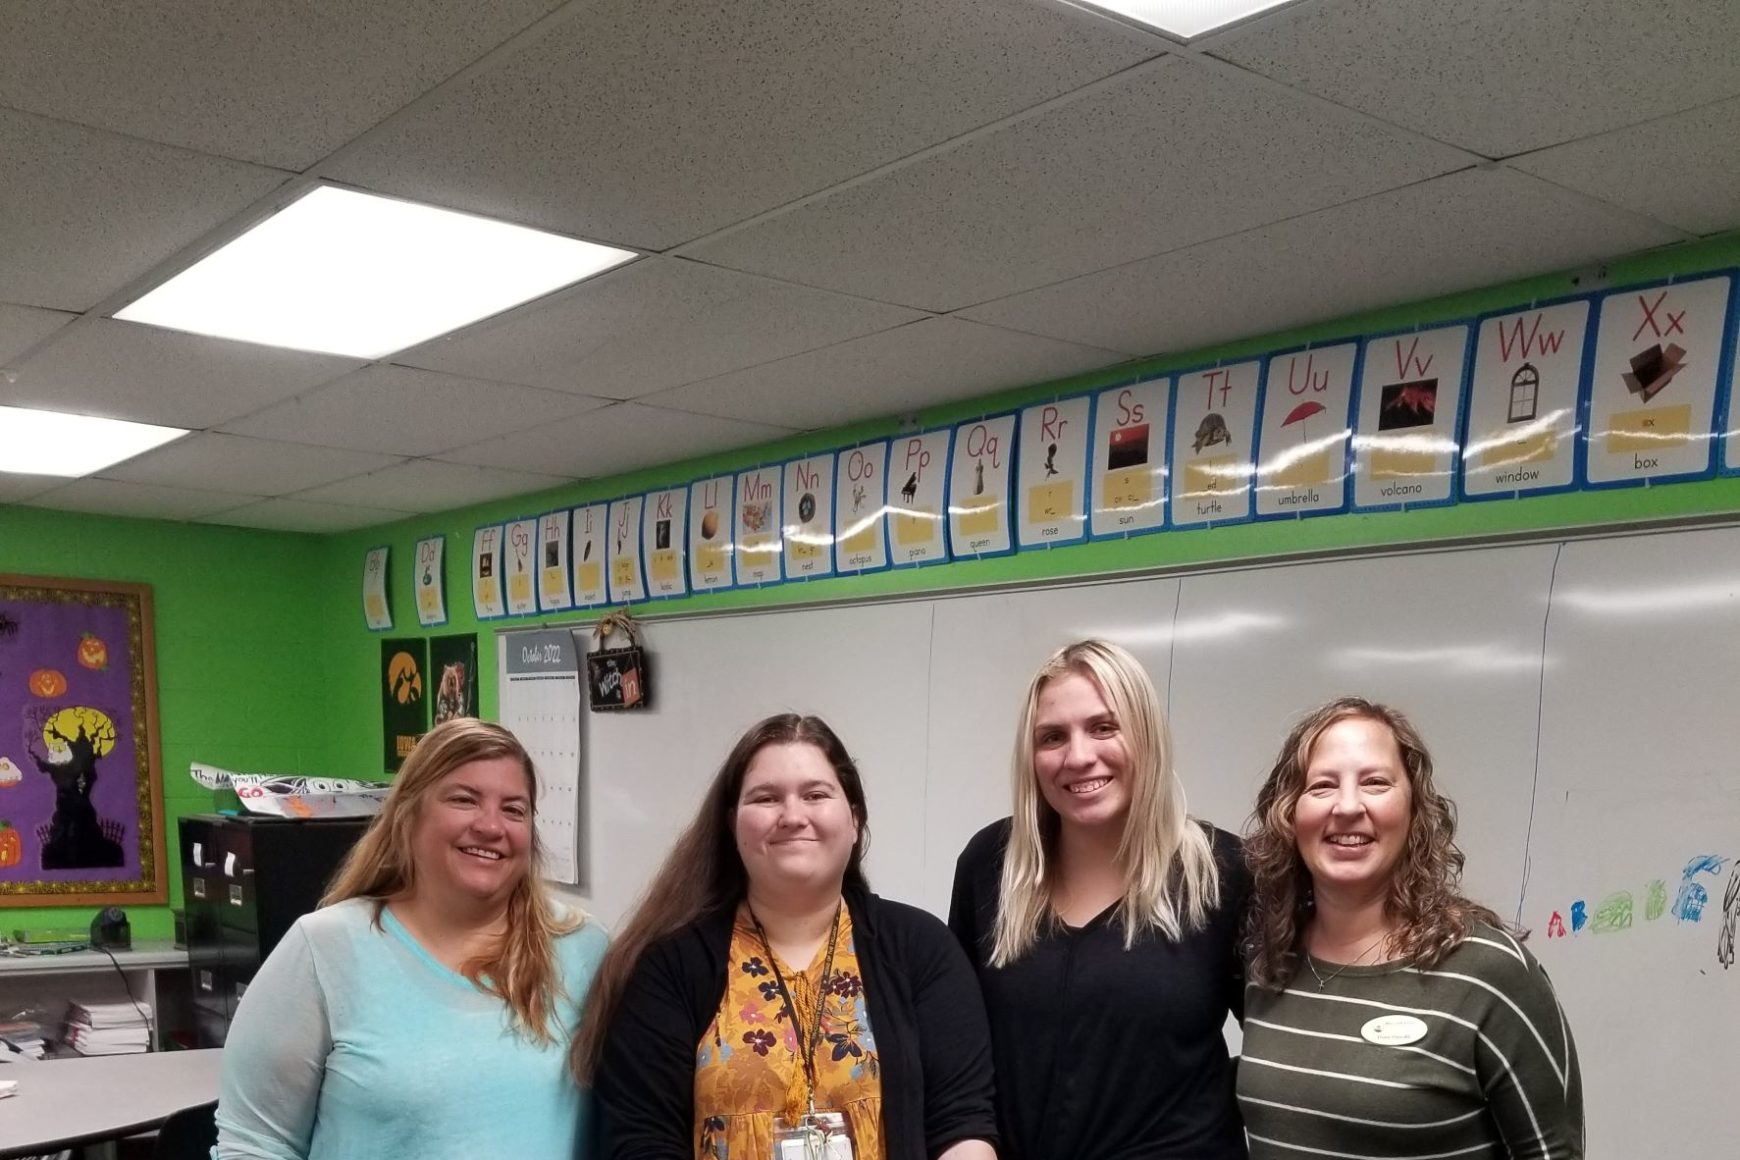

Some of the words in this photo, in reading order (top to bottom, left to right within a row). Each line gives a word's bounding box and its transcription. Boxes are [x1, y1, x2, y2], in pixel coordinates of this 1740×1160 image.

[1632, 290, 1686, 342] Xx
[1498, 312, 1565, 363] Ww
[1396, 336, 1434, 380] Vv
[1202, 369, 1233, 410] Tt
[1288, 353, 1329, 396] Uu
[1041, 406, 1069, 442] Rr
[1116, 389, 1145, 427] Ss
[905, 438, 931, 483] Pp
[967, 424, 1001, 469] Qq
[1634, 452, 1659, 470] box
[796, 461, 820, 492] Nn
[848, 450, 874, 482] Oo
[1495, 466, 1540, 484] window
[743, 473, 772, 502] Mm
[1278, 488, 1320, 506] umbrella
[1380, 481, 1423, 497] volcano
[656, 492, 673, 520] Kk
[1119, 515, 1135, 525] sun
[1197, 500, 1223, 516] turtle
[511, 523, 529, 557] Gg
[1041, 526, 1059, 536] rose
